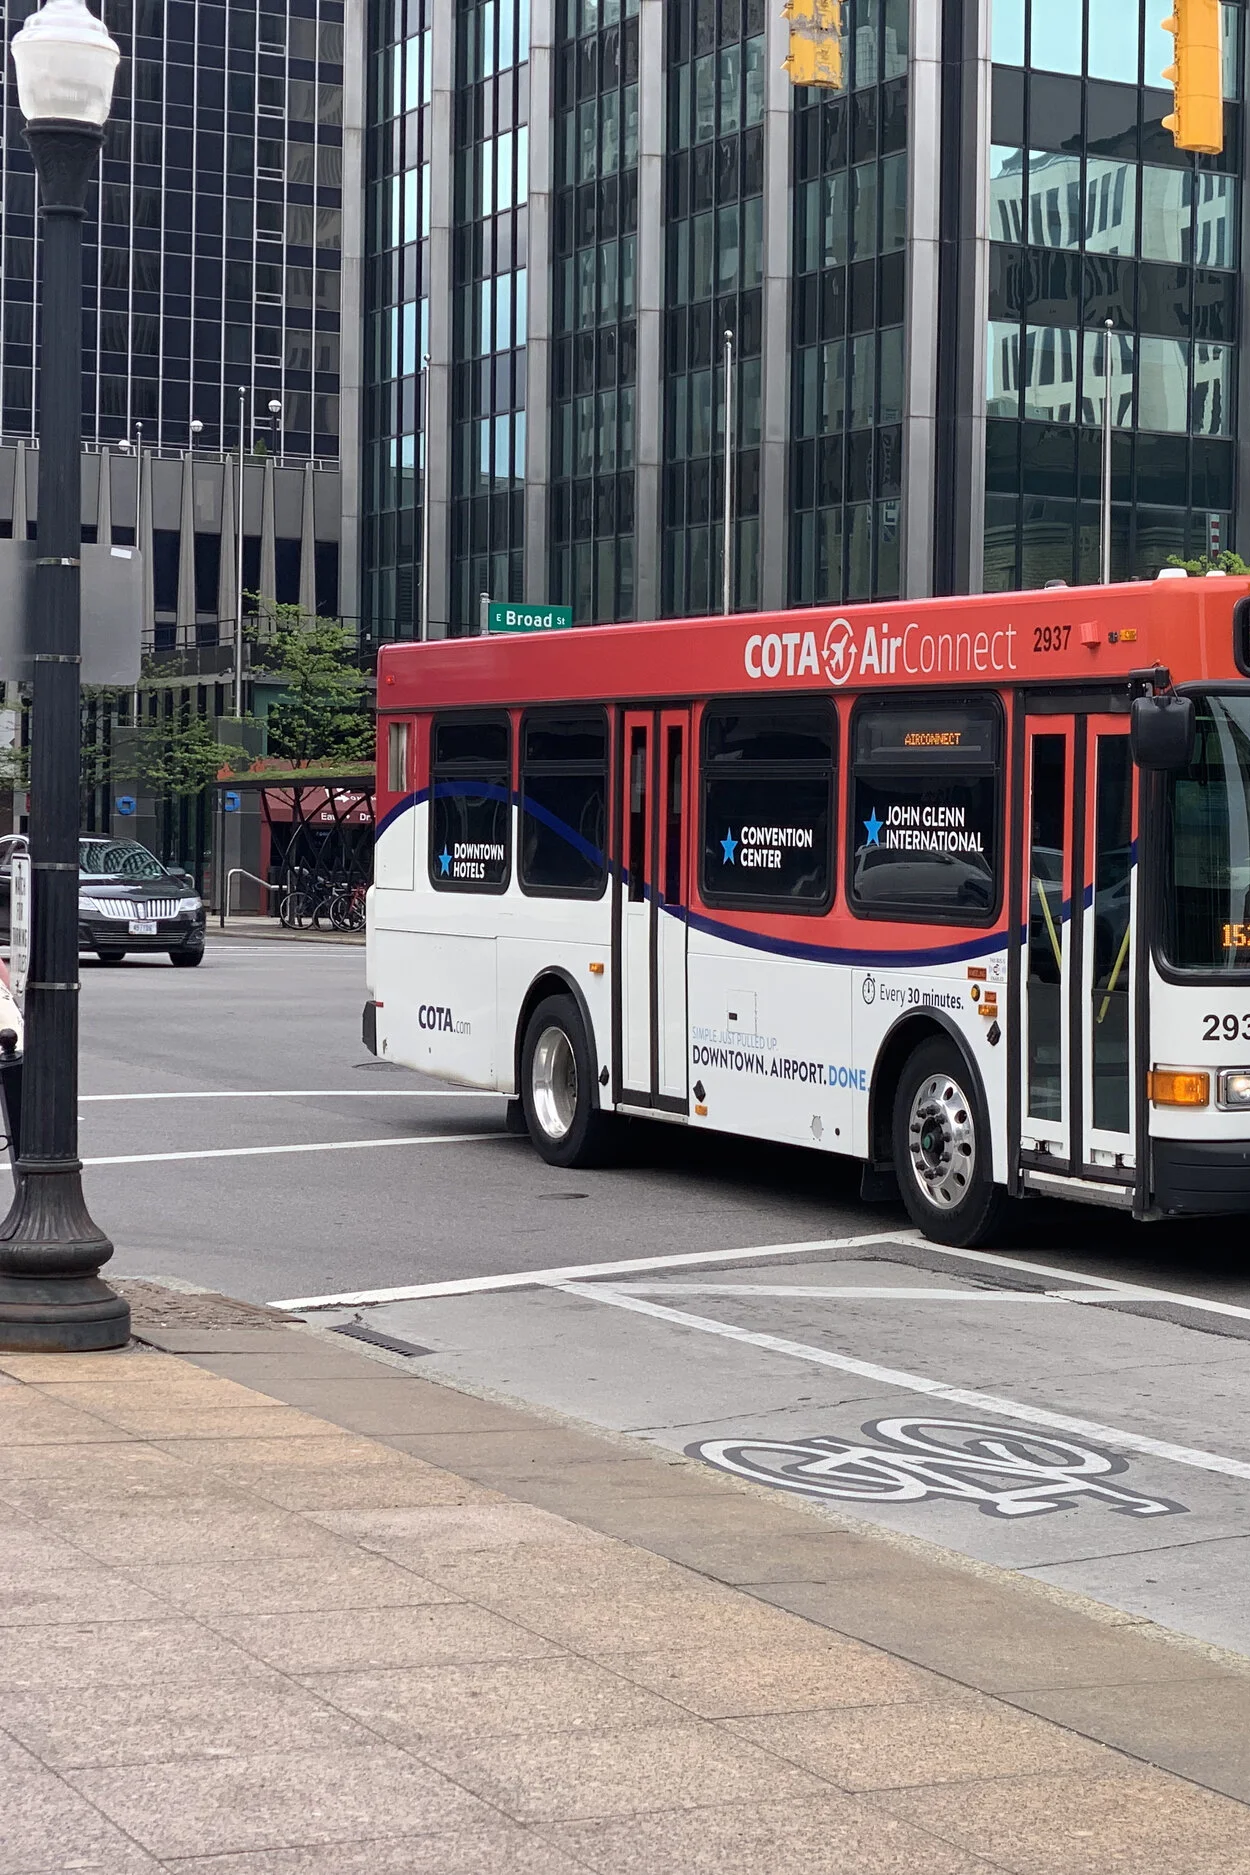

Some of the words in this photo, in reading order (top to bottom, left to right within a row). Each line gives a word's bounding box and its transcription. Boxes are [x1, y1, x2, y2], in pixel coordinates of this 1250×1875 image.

[496, 613, 502, 622] E
[506, 610, 553, 628] Broad
[556, 616, 566, 625] St
[1033, 625, 1072, 653] 2937
[744, 632, 820, 679] COTA
[904, 732, 961, 745] AIRCONNECT
[885, 806, 921, 826] JOHN
[922, 806, 965, 827] GLENN
[740, 826, 813, 848] CONVENTION
[886, 829, 984, 852] INTERNATIONAL
[454, 843, 504, 861] DOWNTOWN
[740, 849, 782, 869] CENTER
[453, 862, 485, 879] HOTELS
[880, 983, 906, 1007] Every
[908, 987, 920, 1004] 30
[922, 988, 964, 1010] minutes.
[418, 1004, 471, 1035] COTA.com
[692, 1026, 717, 1043] SIMPLE
[718, 1030, 736, 1046] JUST
[736, 1033, 766, 1050] PULLED
[692, 1044, 768, 1076] DOWNTOWN.
[770, 1057, 827, 1085] AIRPORT.
